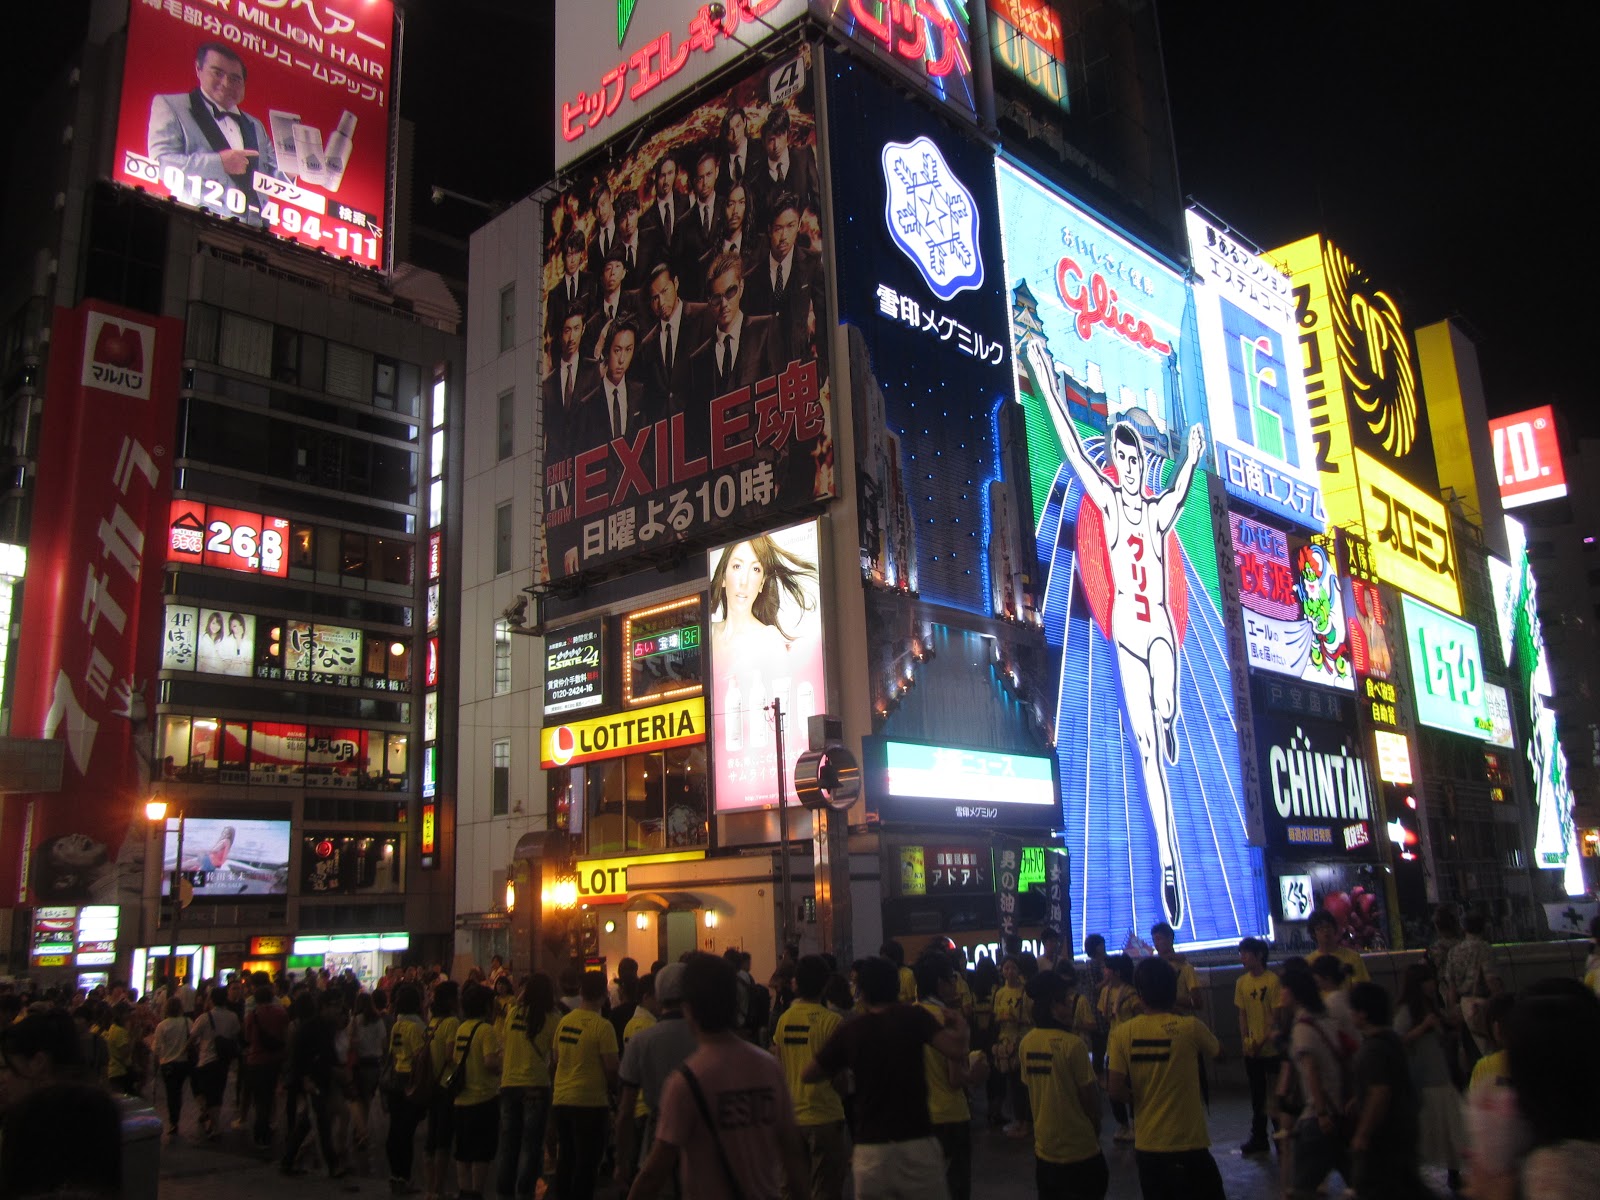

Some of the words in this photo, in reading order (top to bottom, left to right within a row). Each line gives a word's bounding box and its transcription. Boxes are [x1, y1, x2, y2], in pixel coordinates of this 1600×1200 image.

[237, 1, 324, 53] MILLION
[330, 43, 385, 80] HAIR
[774, 60, 799, 92] 4
[257, 177, 302, 200] ルアン
[163, 165, 378, 261] 0120-494-111
[338, 204, 368, 228] 検索
[1057, 257, 1171, 340] Glico
[876, 283, 1003, 365] 雪印メグミルク
[92, 366, 143, 390] マルハン
[574, 358, 826, 520] EXILE魂
[547, 479, 571, 510] TV
[1225, 449, 1328, 522] 日商エステム
[583, 461, 774, 560] 日曜よる10時
[207, 520, 283, 562] 268
[1239, 519, 1286, 559] かぜに
[1371, 485, 1454, 580] プロミス
[1126, 532, 1151, 623] グリコ
[1237, 551, 1297, 606] 改源
[170, 611, 193, 628] 4F
[291, 626, 356, 669] はなこ
[634, 642, 653, 656] 占い
[684, 629, 697, 645] 3F
[552, 684, 593, 699] 0120-2424-16
[1366, 678, 1396, 703] 食べ放題
[308, 737, 354, 761] 風月
[580, 709, 695, 752] LOTTERIA
[1269, 725, 1369, 820] CHINTAI
[955, 806, 998, 819] 雪印メグミルク
[932, 868, 985, 886] アドアド
